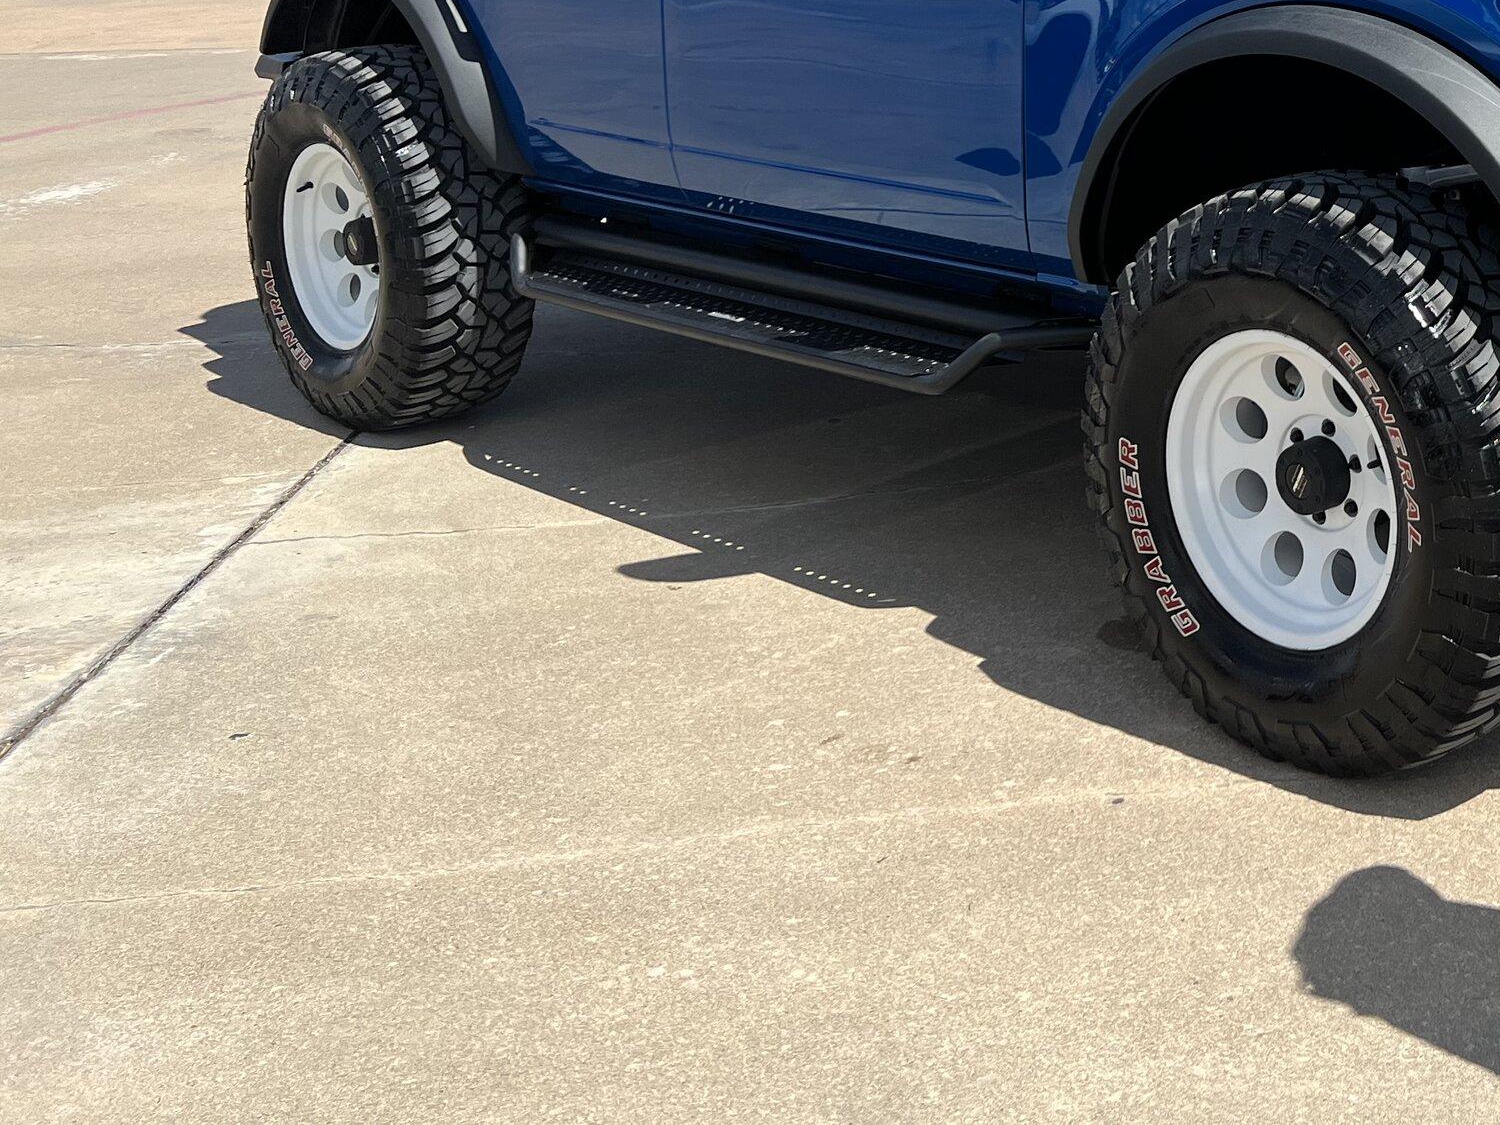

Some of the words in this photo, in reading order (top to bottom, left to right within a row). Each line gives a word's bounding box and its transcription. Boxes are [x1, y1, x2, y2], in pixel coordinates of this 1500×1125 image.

[262, 260, 314, 370] GENERAL
[1118, 436, 1200, 637] GRABBER
[1337, 341, 1422, 553] GENERAL
